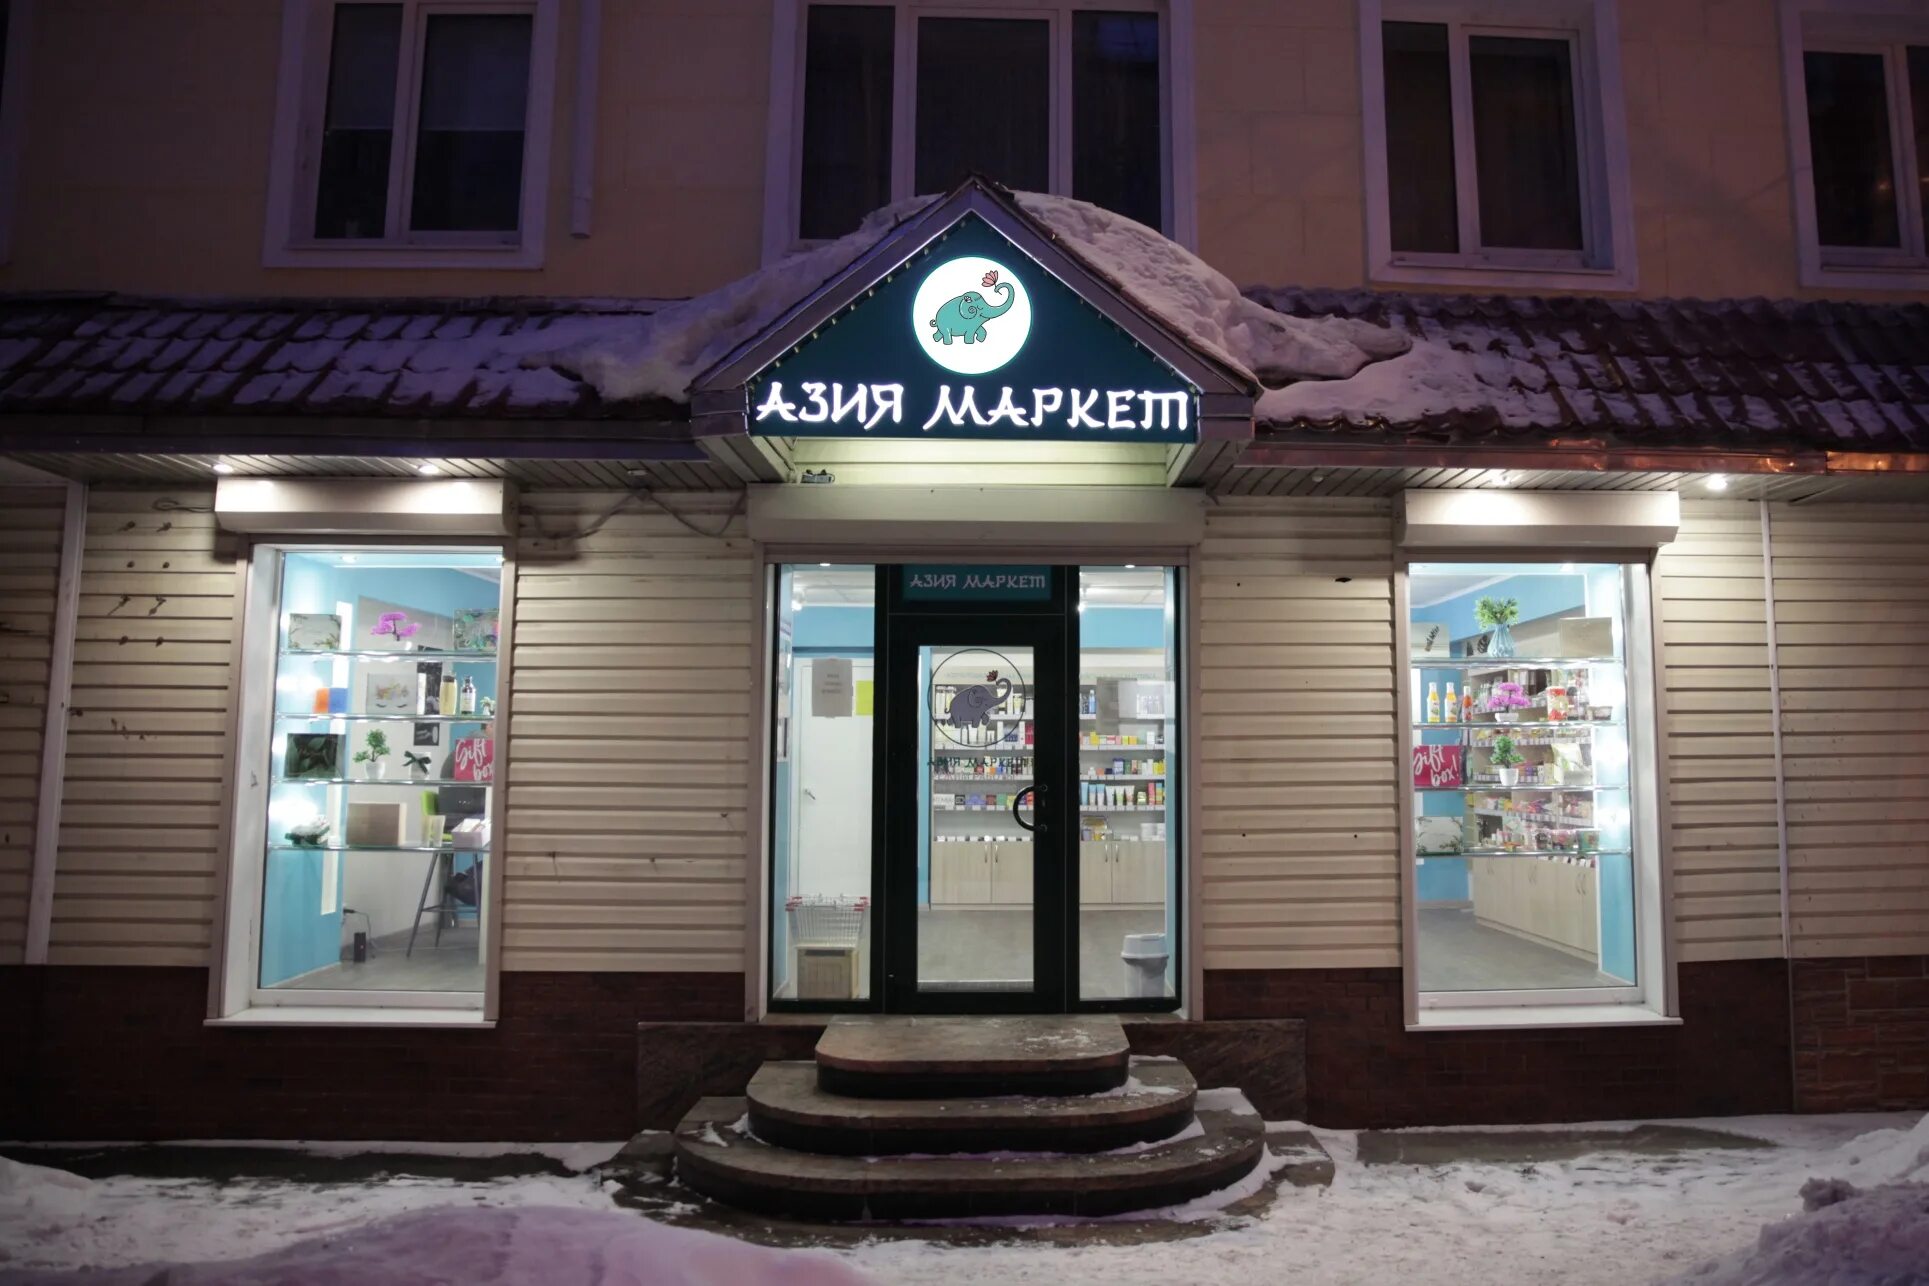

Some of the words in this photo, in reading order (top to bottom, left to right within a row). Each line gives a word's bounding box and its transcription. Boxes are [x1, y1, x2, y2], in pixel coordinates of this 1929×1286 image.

[755, 381, 904, 430] АЗИЯ
[922, 384, 1189, 431] МАРКЕТ
[909, 574, 957, 590] АЗИЯ
[962, 574, 1046, 590] МАРКЕТ
